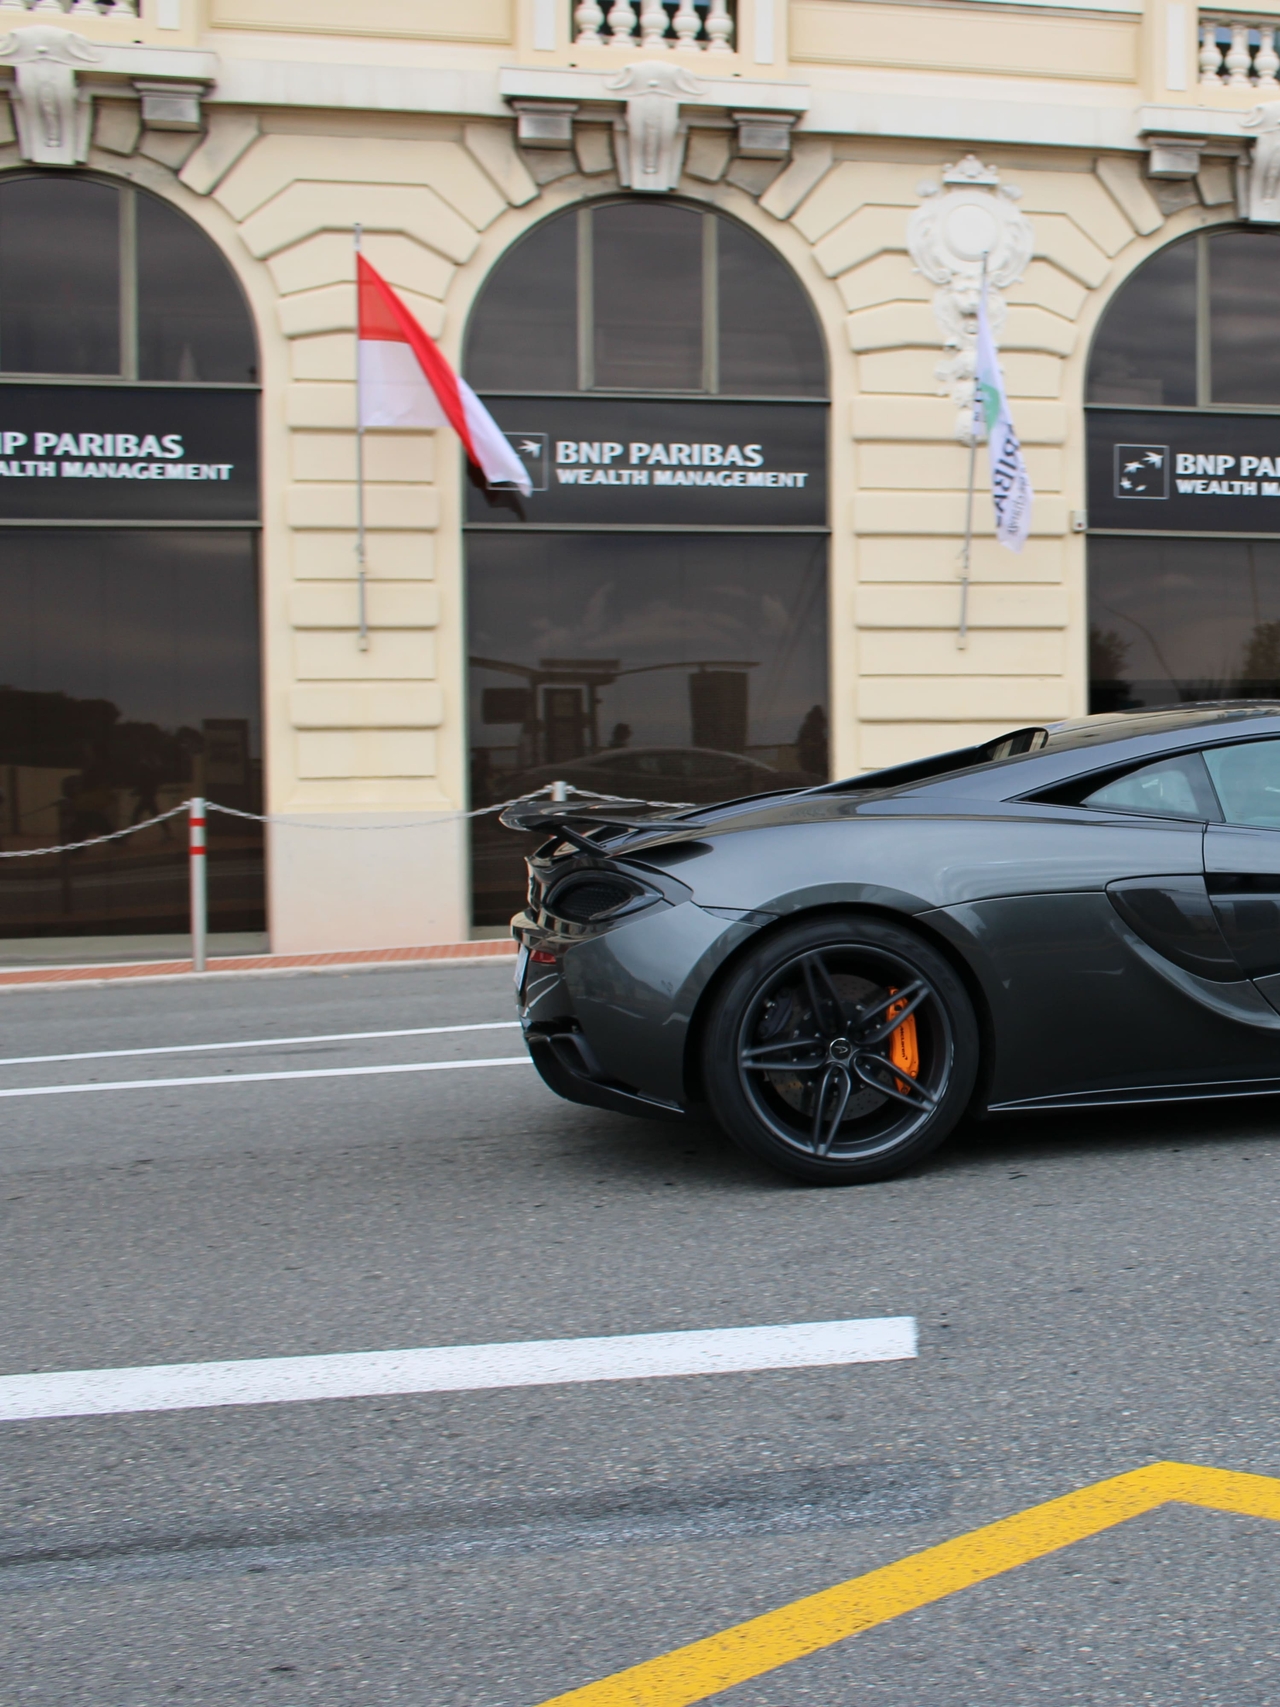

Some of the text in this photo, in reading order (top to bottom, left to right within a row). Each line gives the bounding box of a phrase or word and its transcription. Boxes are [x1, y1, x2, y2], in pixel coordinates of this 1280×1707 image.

[33, 432, 185, 459] PARIBAS
[555, 441, 764, 467] BNP PARIBAS
[61, 461, 234, 480] MANAGEMENT
[1175, 453, 1236, 476] BNP
[555, 468, 809, 488] WEALTH MANAGEMENT
[1175, 479, 1258, 495] WEALTH
